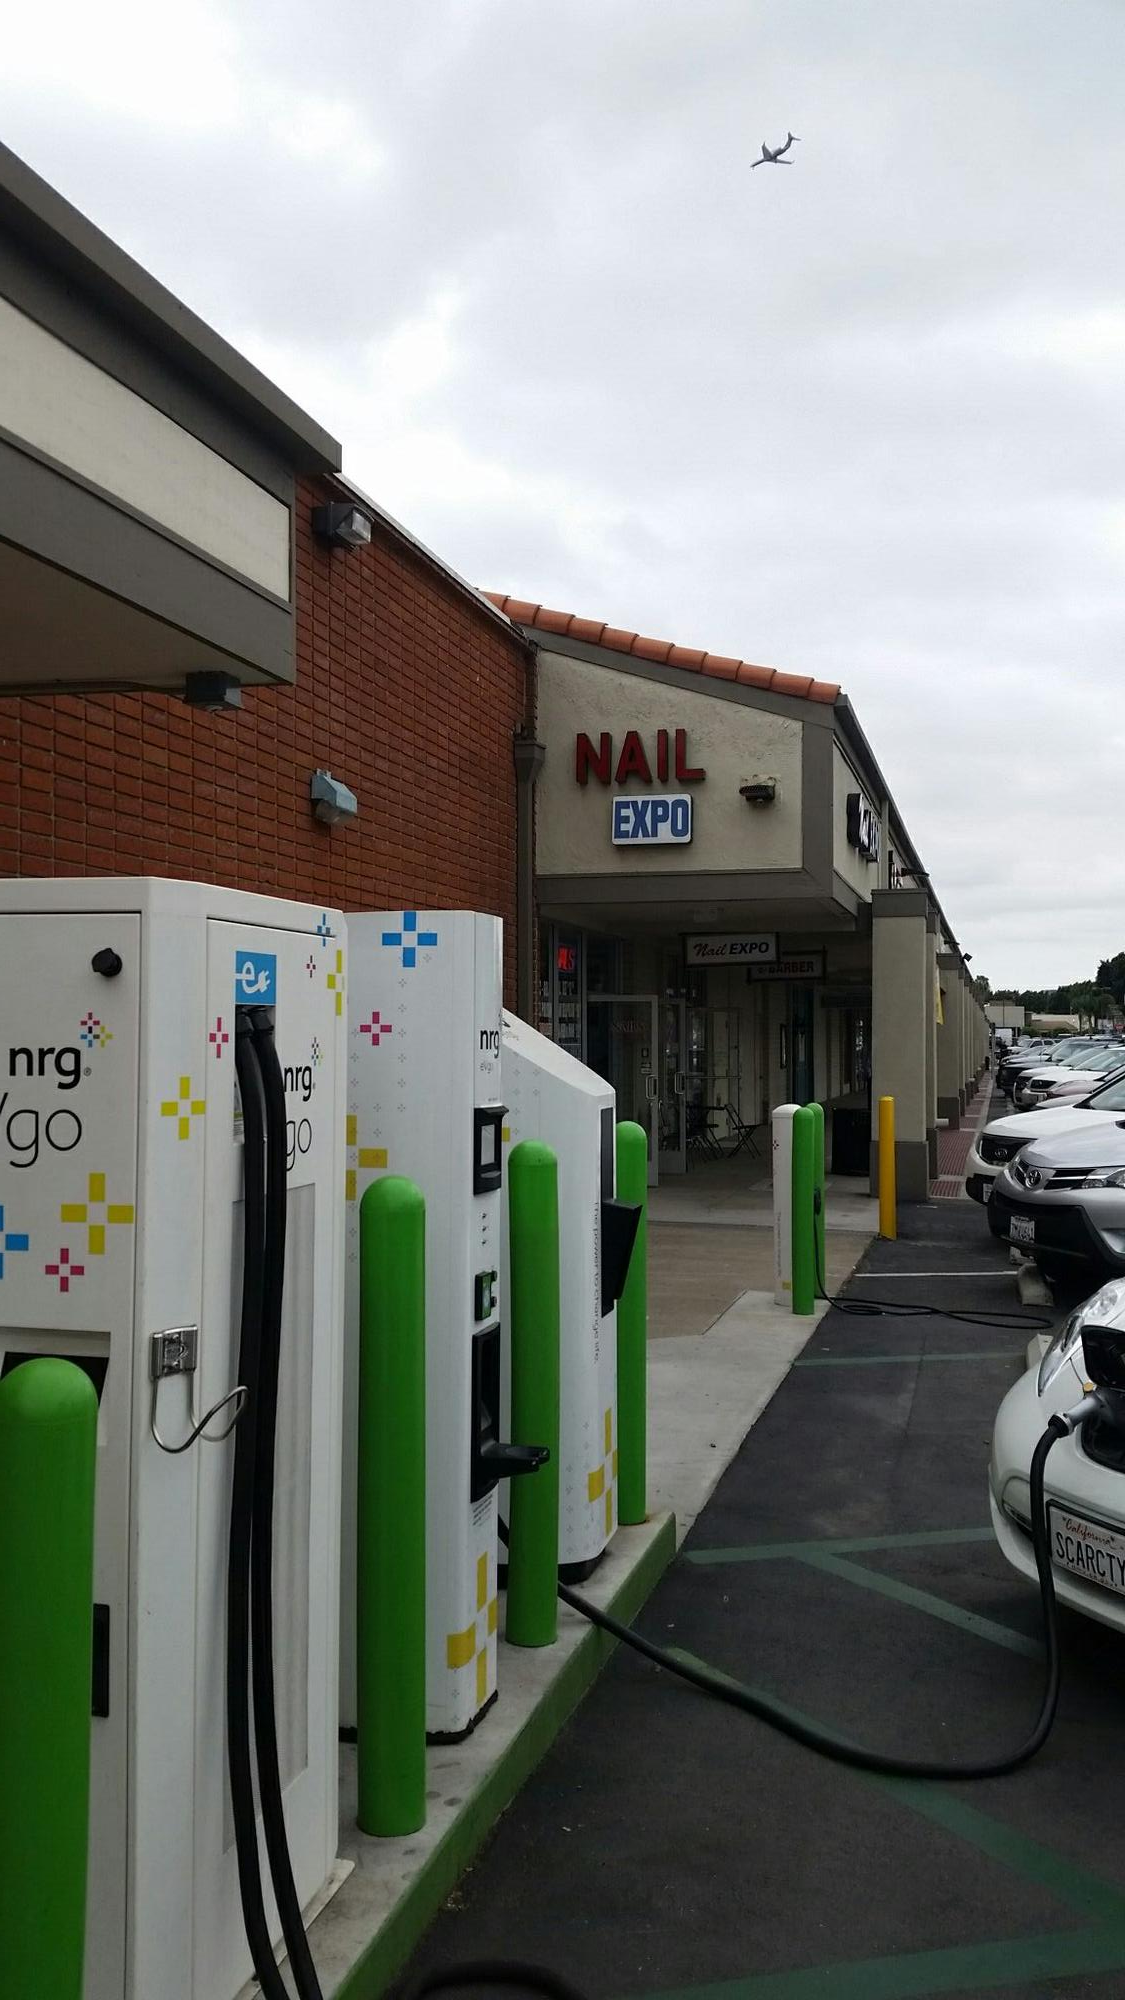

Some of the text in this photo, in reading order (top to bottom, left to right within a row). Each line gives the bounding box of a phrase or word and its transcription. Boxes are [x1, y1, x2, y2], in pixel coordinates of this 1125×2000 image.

[576, 728, 706, 785] NAIL
[614, 799, 689, 839] EXPO
[693, 942, 769, 958] Nail EXPO
[769, 960, 814, 974] BARBER
[0, 1092, 83, 1169] go
[592, 1227, 600, 1269] power
[593, 1272, 600, 1287] to
[591, 1288, 600, 1340] change
[1065, 1518, 1112, 1545] California
